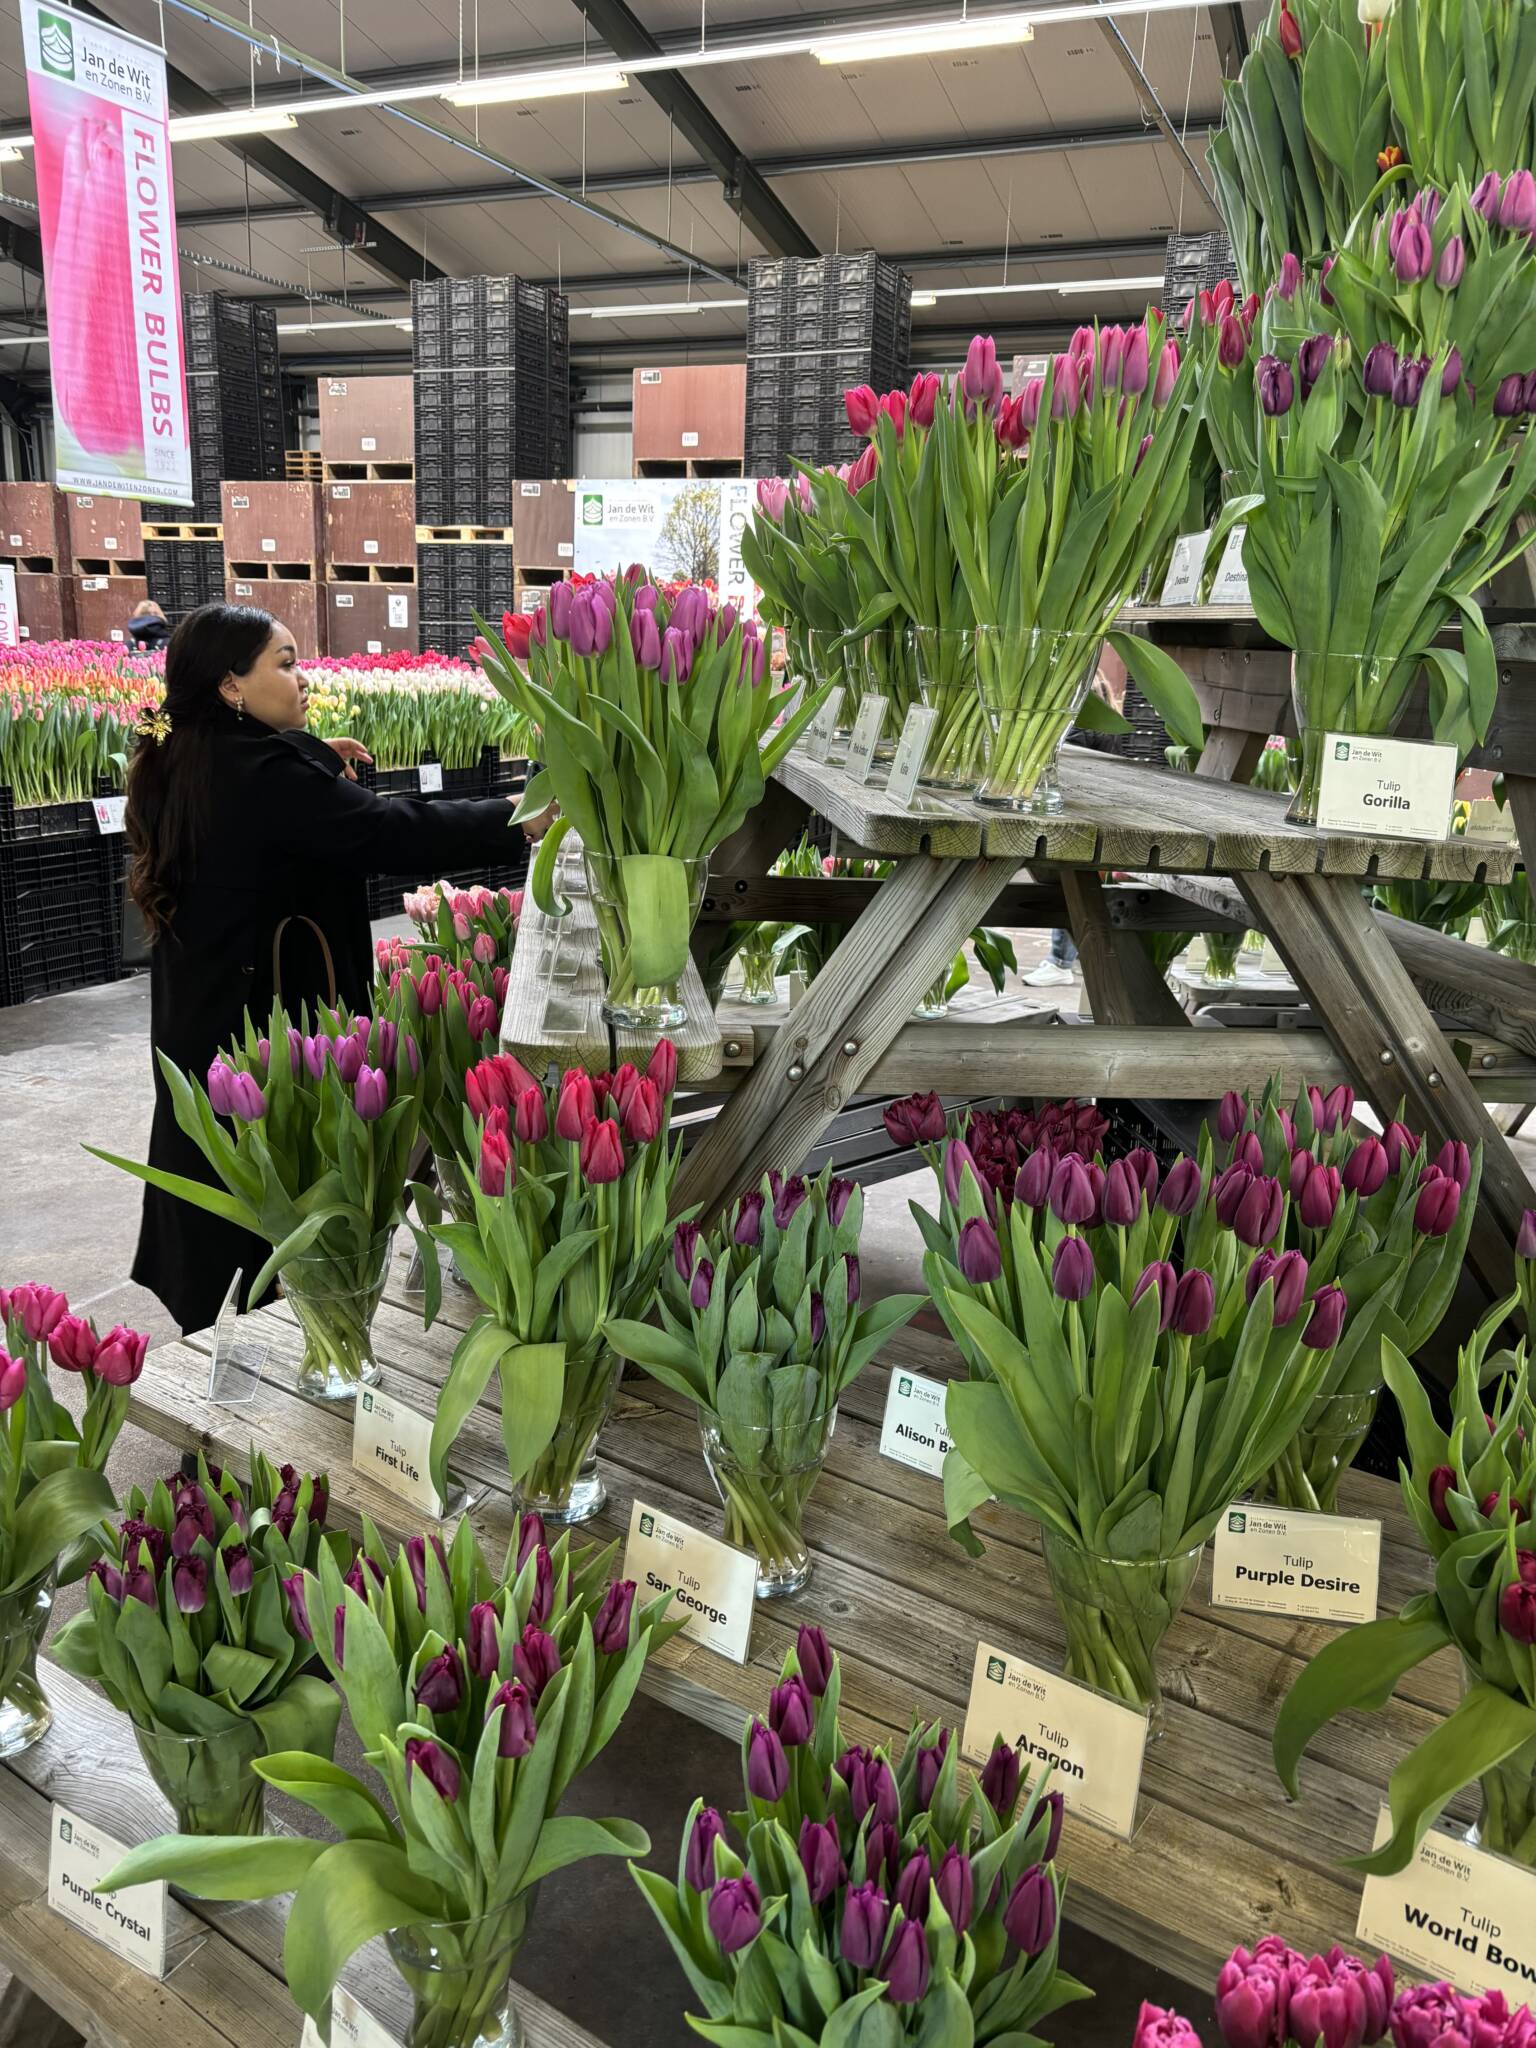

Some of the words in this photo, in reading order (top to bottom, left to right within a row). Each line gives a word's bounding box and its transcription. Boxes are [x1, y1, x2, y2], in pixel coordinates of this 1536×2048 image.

[81, 46, 105, 71] Jan
[109, 58, 125, 78] de
[127, 65, 151, 89] Wit
[85, 69, 99, 84] en
[100, 73, 132, 97] Zonen
[134, 127, 163, 296] FLOWER
[144, 311, 172, 437] BULBS
[607, 504, 624, 514] Jan
[626, 503, 637, 513] de
[638, 504, 654, 514] Wit
[1377, 780, 1401, 793] Tulip
[1362, 793, 1411, 810] Gorilla
[895, 1424, 935, 1449] Alison
[939, 1441, 952, 1453] B
[934, 1423, 951, 1438] Tuli
[390, 1440, 406, 1457] Tulip
[375, 1446, 398, 1469] First
[400, 1461, 419, 1482] Life
[1249, 1520, 1261, 1528] Jan
[1263, 1521, 1273, 1529] de
[1283, 1554, 1314, 1570] Tulip
[677, 1570, 701, 1591] Tulip
[1236, 1565, 1295, 1586] Purple
[1301, 1574, 1360, 1594] Desire
[646, 1572, 672, 1593] San
[676, 1588, 728, 1625] George
[1008, 1673, 1021, 1684] Jan
[1022, 1678, 1032, 1689] de
[1033, 1683, 1047, 1696] Wit
[1038, 1723, 1069, 1748] Tulip
[1015, 1734, 1084, 1779] Aragon
[1420, 1846, 1437, 1861] Jan
[1439, 1853, 1451, 1866] de
[1453, 1860, 1471, 1875] Wit
[62, 1872, 102, 1910] Purple
[105, 1902, 150, 1941] Crystal
[1460, 1906, 1501, 1938] Tulip
[1404, 1903, 1478, 1954] World
[1486, 1943, 1536, 1984] Bow
